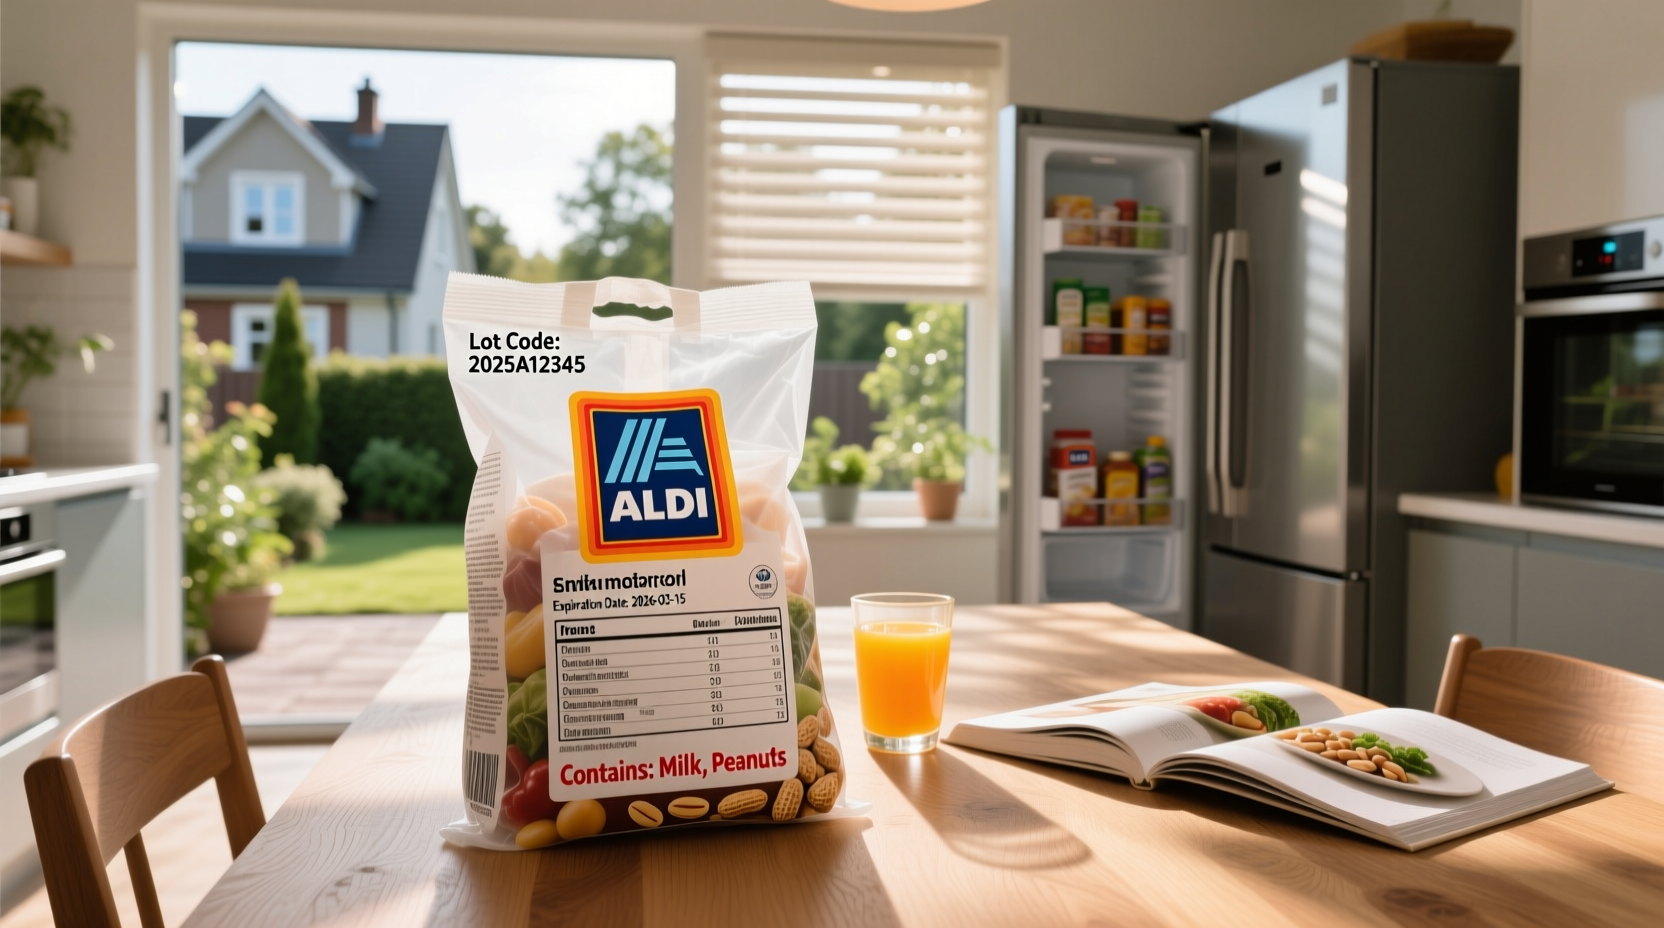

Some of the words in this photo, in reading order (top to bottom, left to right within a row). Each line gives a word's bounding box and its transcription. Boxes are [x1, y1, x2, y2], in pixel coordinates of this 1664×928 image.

[469, 332, 502, 351] Lot
[506, 331, 561, 351] Code:
[468, 355, 587, 375] 2025A12345
[609, 487, 709, 523] ALDI
[560, 759, 654, 786] Contains:
[659, 752, 708, 779] Milk,
[712, 746, 788, 773] Peanuts
